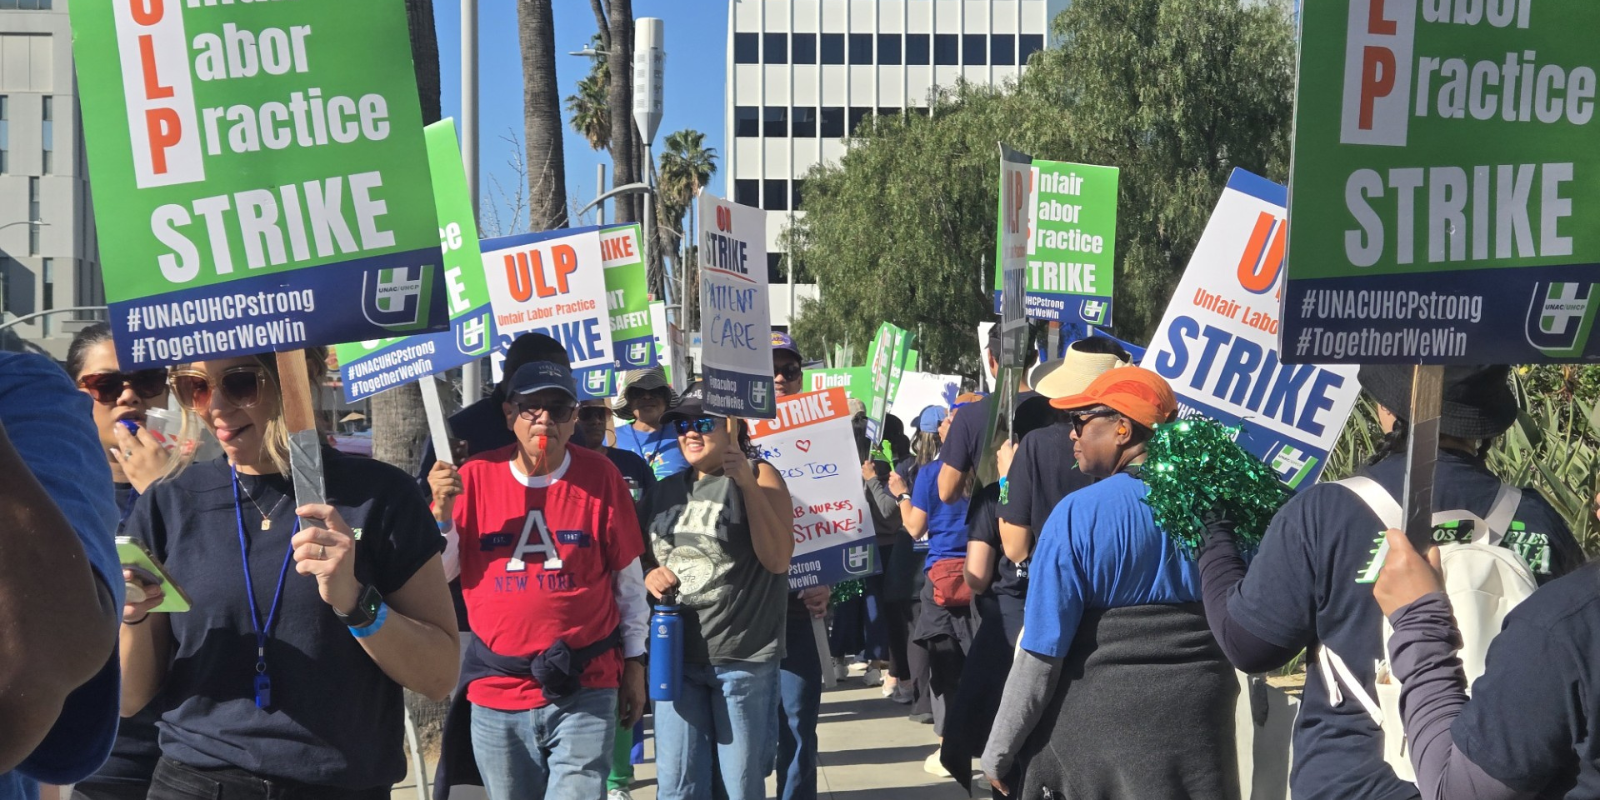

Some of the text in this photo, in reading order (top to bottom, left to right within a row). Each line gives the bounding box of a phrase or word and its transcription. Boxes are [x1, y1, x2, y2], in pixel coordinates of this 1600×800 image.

[150, 170, 397, 284] STRIKE
[716, 205, 732, 234] ON
[1027, 199, 1083, 224] abor
[1344, 162, 1574, 268] STRIKE
[705, 230, 748, 274] STRIKE
[503, 244, 577, 303] ULP
[1026, 260, 1097, 293] TRIKE
[126, 288, 315, 332] #UNACUHCPstrong
[498, 298, 596, 326] Unfair Labor Practice
[704, 278, 758, 314] PATIENT
[1193, 287, 1278, 335] Unfair Labo
[1301, 290, 1483, 323] #UNACUHCPstrong
[131, 319, 307, 363] #TogetherWeWin
[710, 316, 758, 350] CARE
[1296, 327, 1468, 360] #TogetherWeWin
[347, 340, 435, 380] #UNACUHCPstrong
[351, 359, 433, 397] #TogetherWeWin
[804, 461, 838, 475] TOO
[809, 499, 853, 515] NURSES
[505, 509, 563, 573] A
[793, 508, 863, 544] STRIKE!
[494, 573, 577, 592] NEW YORK
